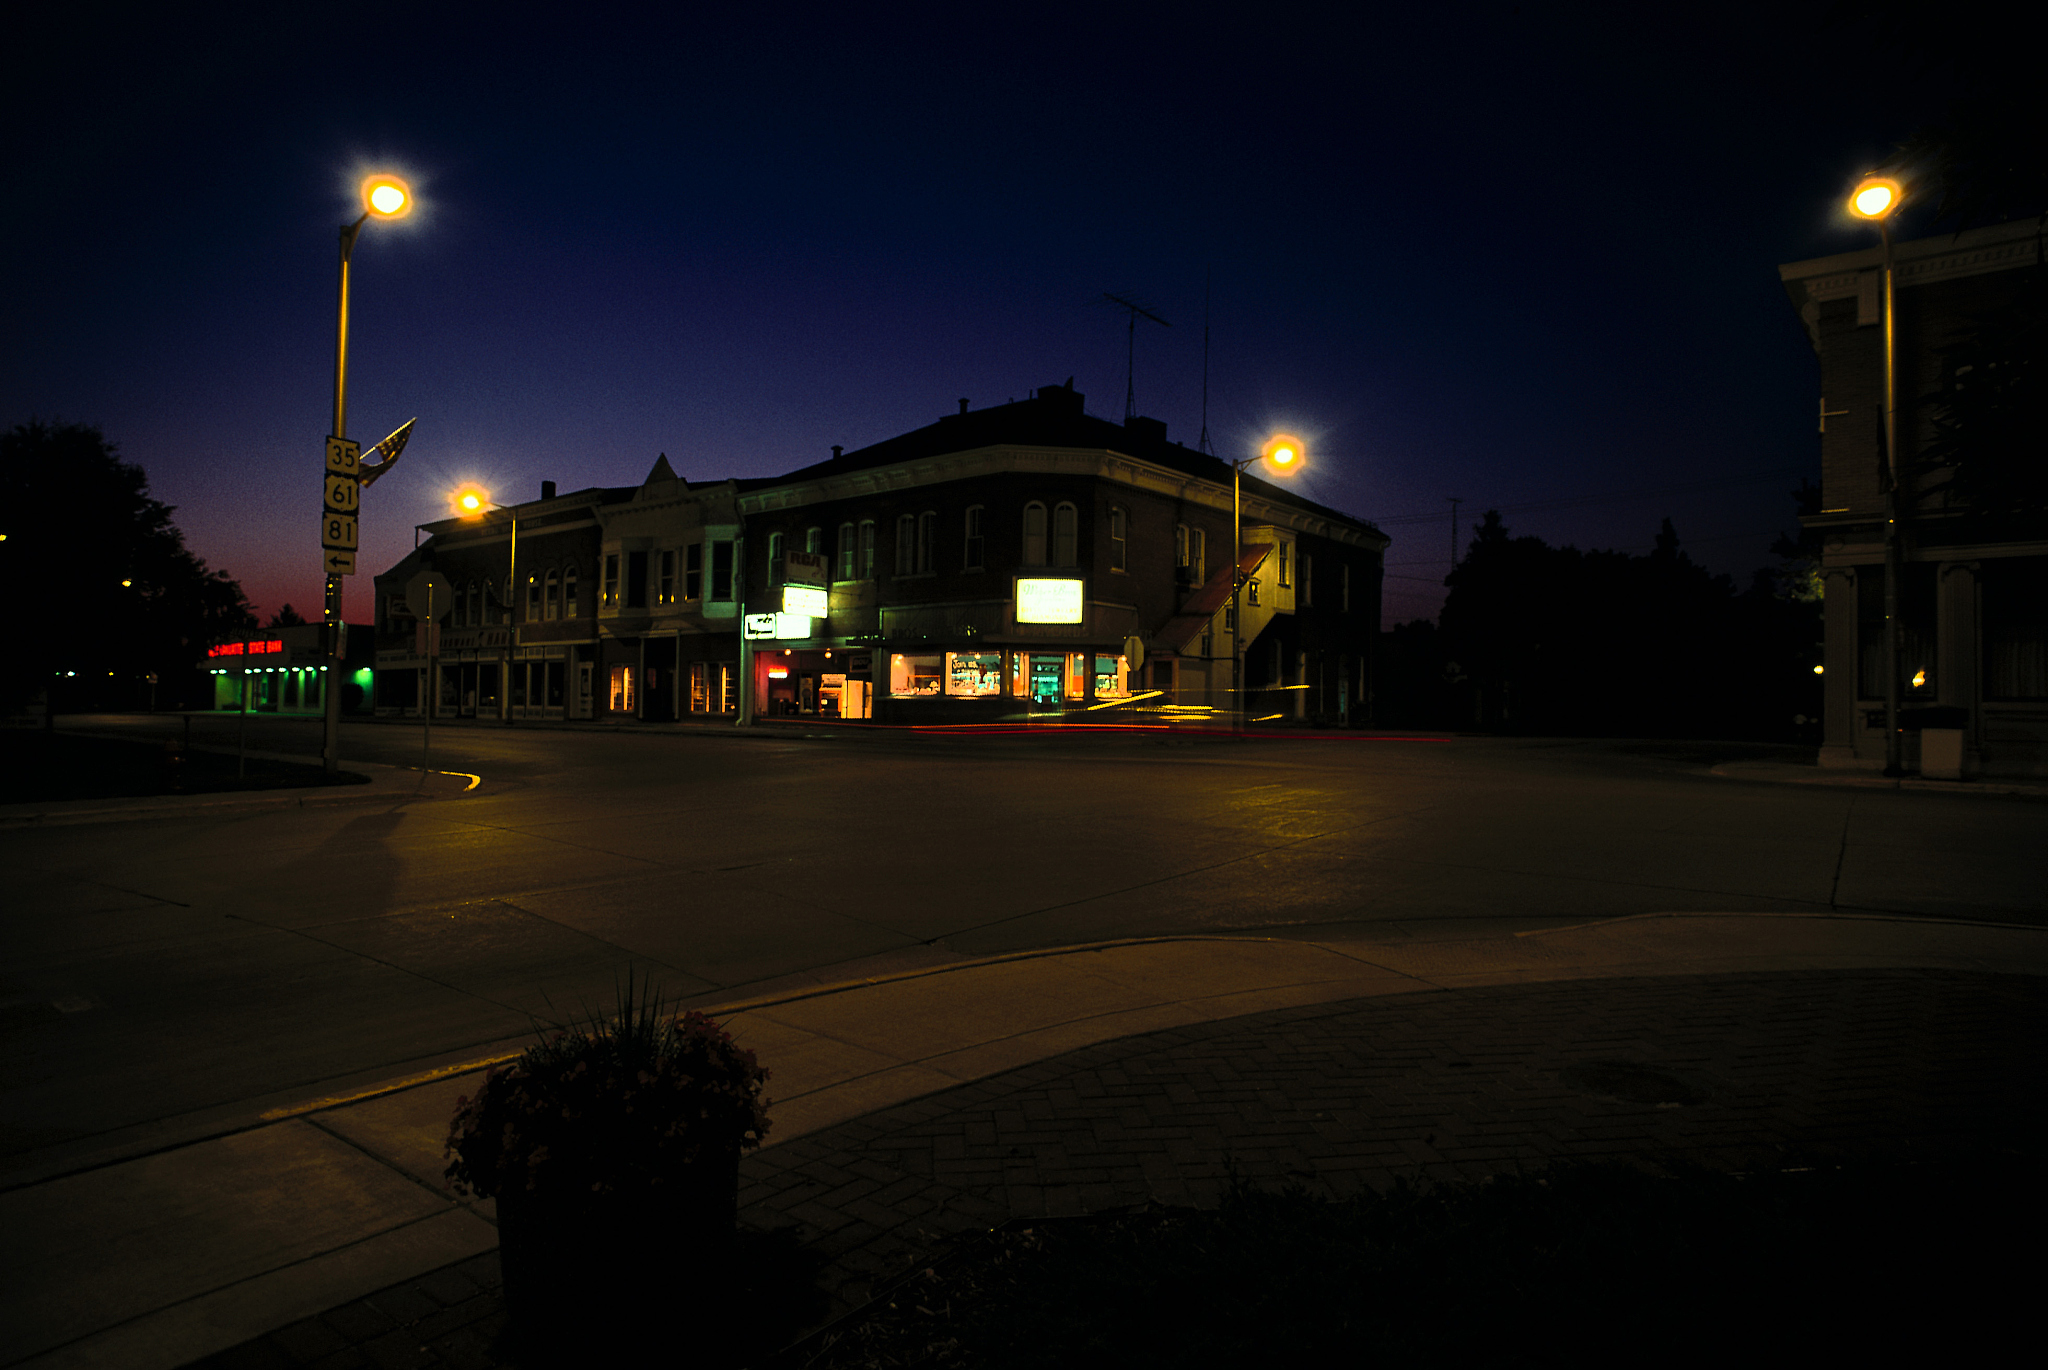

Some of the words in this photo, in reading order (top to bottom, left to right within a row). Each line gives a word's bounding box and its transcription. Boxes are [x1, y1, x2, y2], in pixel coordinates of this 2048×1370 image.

[332, 445, 355, 468] 35
[332, 484, 352, 505] 61
[329, 520, 351, 542] 81
[790, 552, 821, 567] RCA
